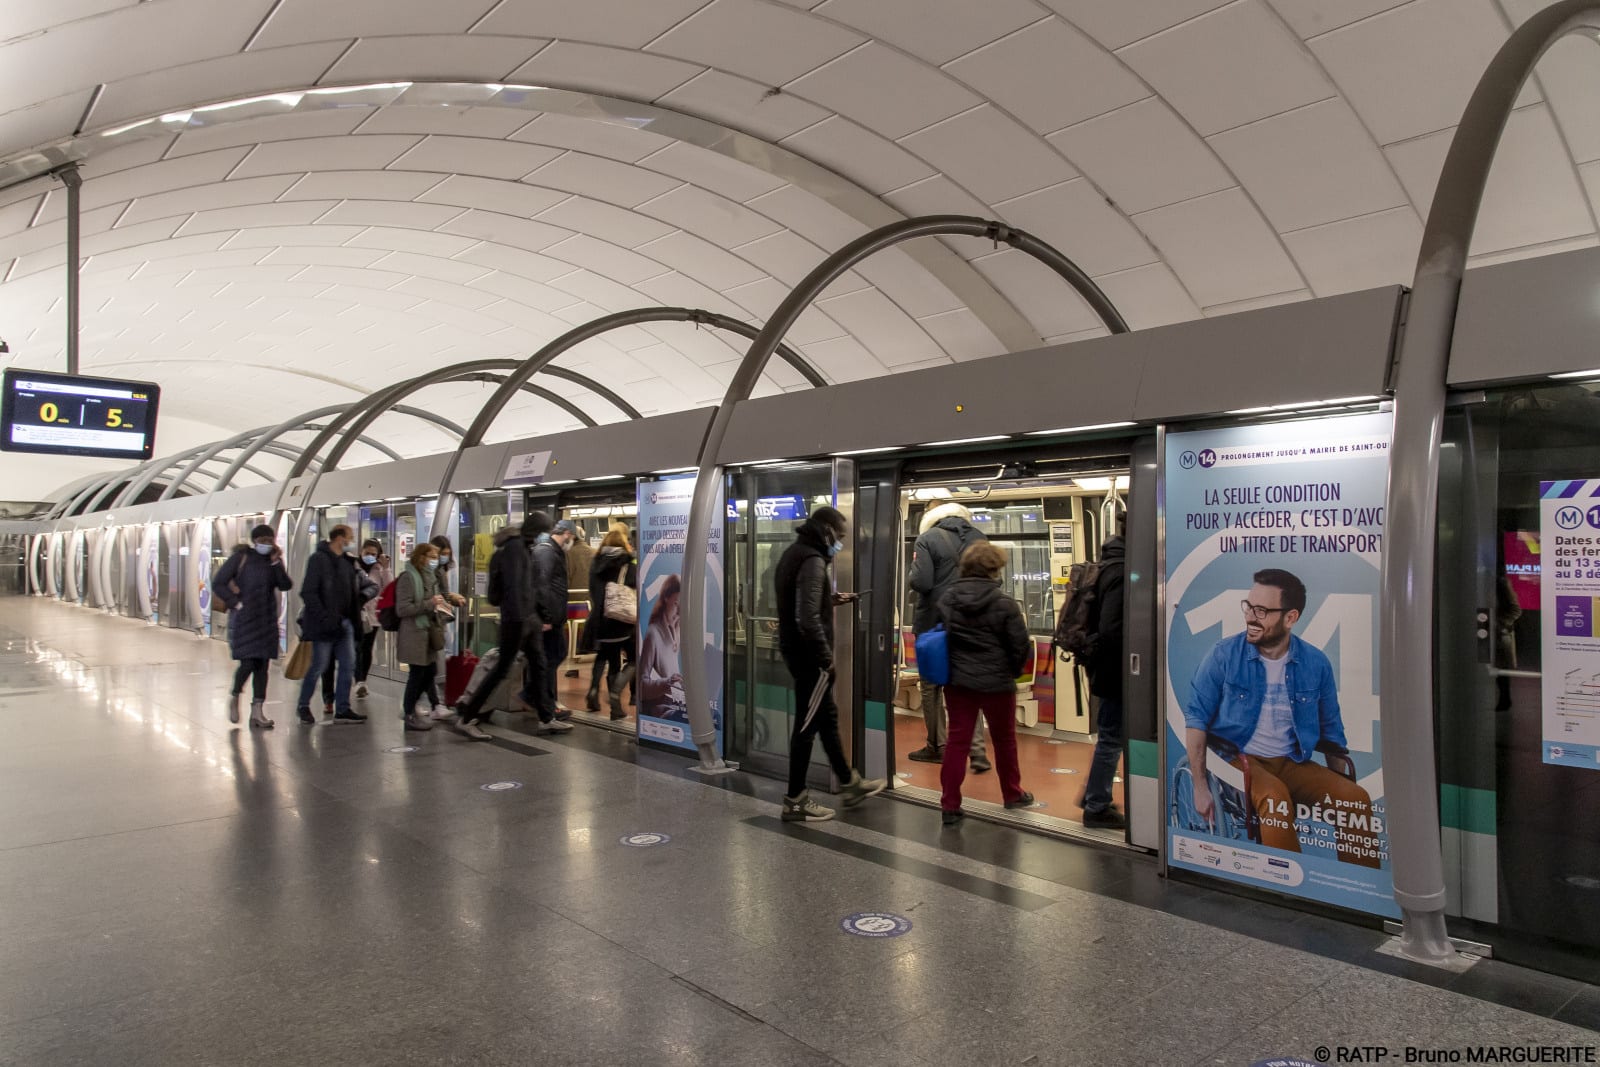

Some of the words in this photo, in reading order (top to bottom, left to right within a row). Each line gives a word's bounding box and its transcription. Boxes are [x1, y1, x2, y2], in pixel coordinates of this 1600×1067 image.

[40, 402, 58, 423] 0
[105, 408, 122, 427] 5
[1200, 453, 1216, 465] 14
[1221, 451, 1274, 460] PROLONGEMENT
[1309, 446, 1336, 454] MAIRIE
[1205, 489, 1220, 505] LA
[1224, 486, 1261, 505] SEULE
[1265, 483, 1341, 503] CONDITION
[1186, 512, 1219, 530] POUR
[1224, 512, 1232, 529] Y
[1235, 507, 1296, 532] ACCÉDER,
[1301, 508, 1338, 528] C'EST
[1589, 509, 1600, 525] 1
[1220, 536, 1238, 554] UN
[1242, 535, 1275, 554] TITRE
[1280, 535, 1297, 553] DE
[1555, 536, 1592, 546] Dates
[1555, 547, 1578, 556] des
[1555, 558, 1571, 567] du
[1576, 558, 1590, 567] 13
[1555, 570, 1571, 578] au
[1575, 569, 1583, 578] 8
[1323, 793, 1333, 804] À
[1335, 798, 1367, 811] partir
[1371, 803, 1385, 813] du
[1266, 798, 1289, 817] 14
[1297, 802, 1388, 834] DÉCEMB
[1259, 816, 1289, 829] votre
[1292, 822, 1310, 834] vie
[1313, 828, 1328, 837] va
[1333, 826, 1388, 850] changer,
